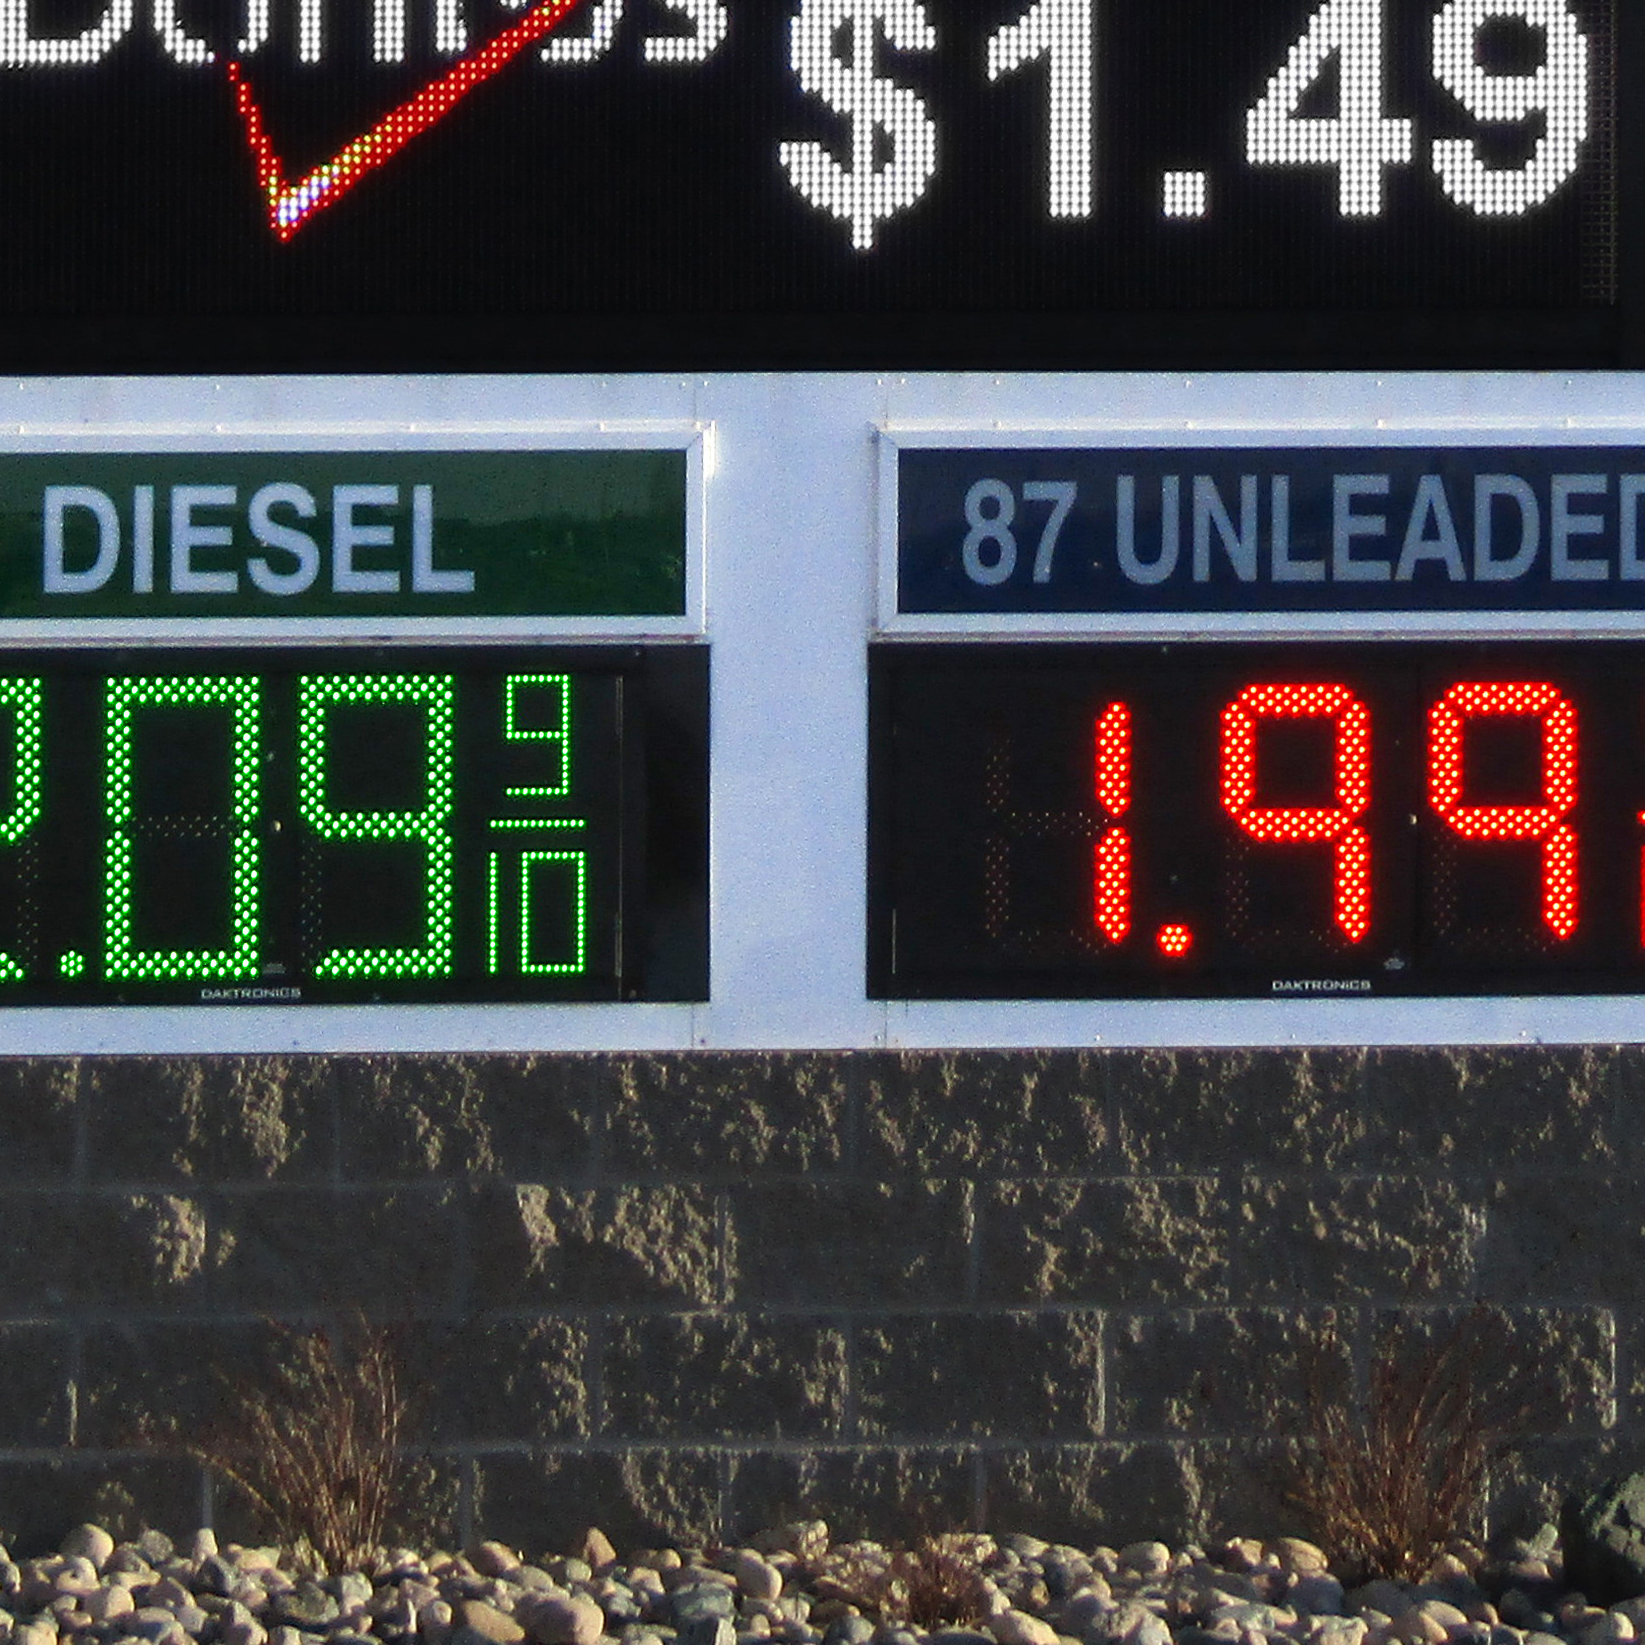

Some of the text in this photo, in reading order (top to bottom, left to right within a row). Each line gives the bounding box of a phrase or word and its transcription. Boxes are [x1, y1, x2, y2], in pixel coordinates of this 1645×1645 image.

[43, 482, 476, 595] DIESEL
[961, 477, 1077, 586] 87
[1093, 681, 1579, 957] 1.99
[201, 987, 301, 999] DAKTRONICS
[1272, 979, 1371, 991] DAKTRONICS
